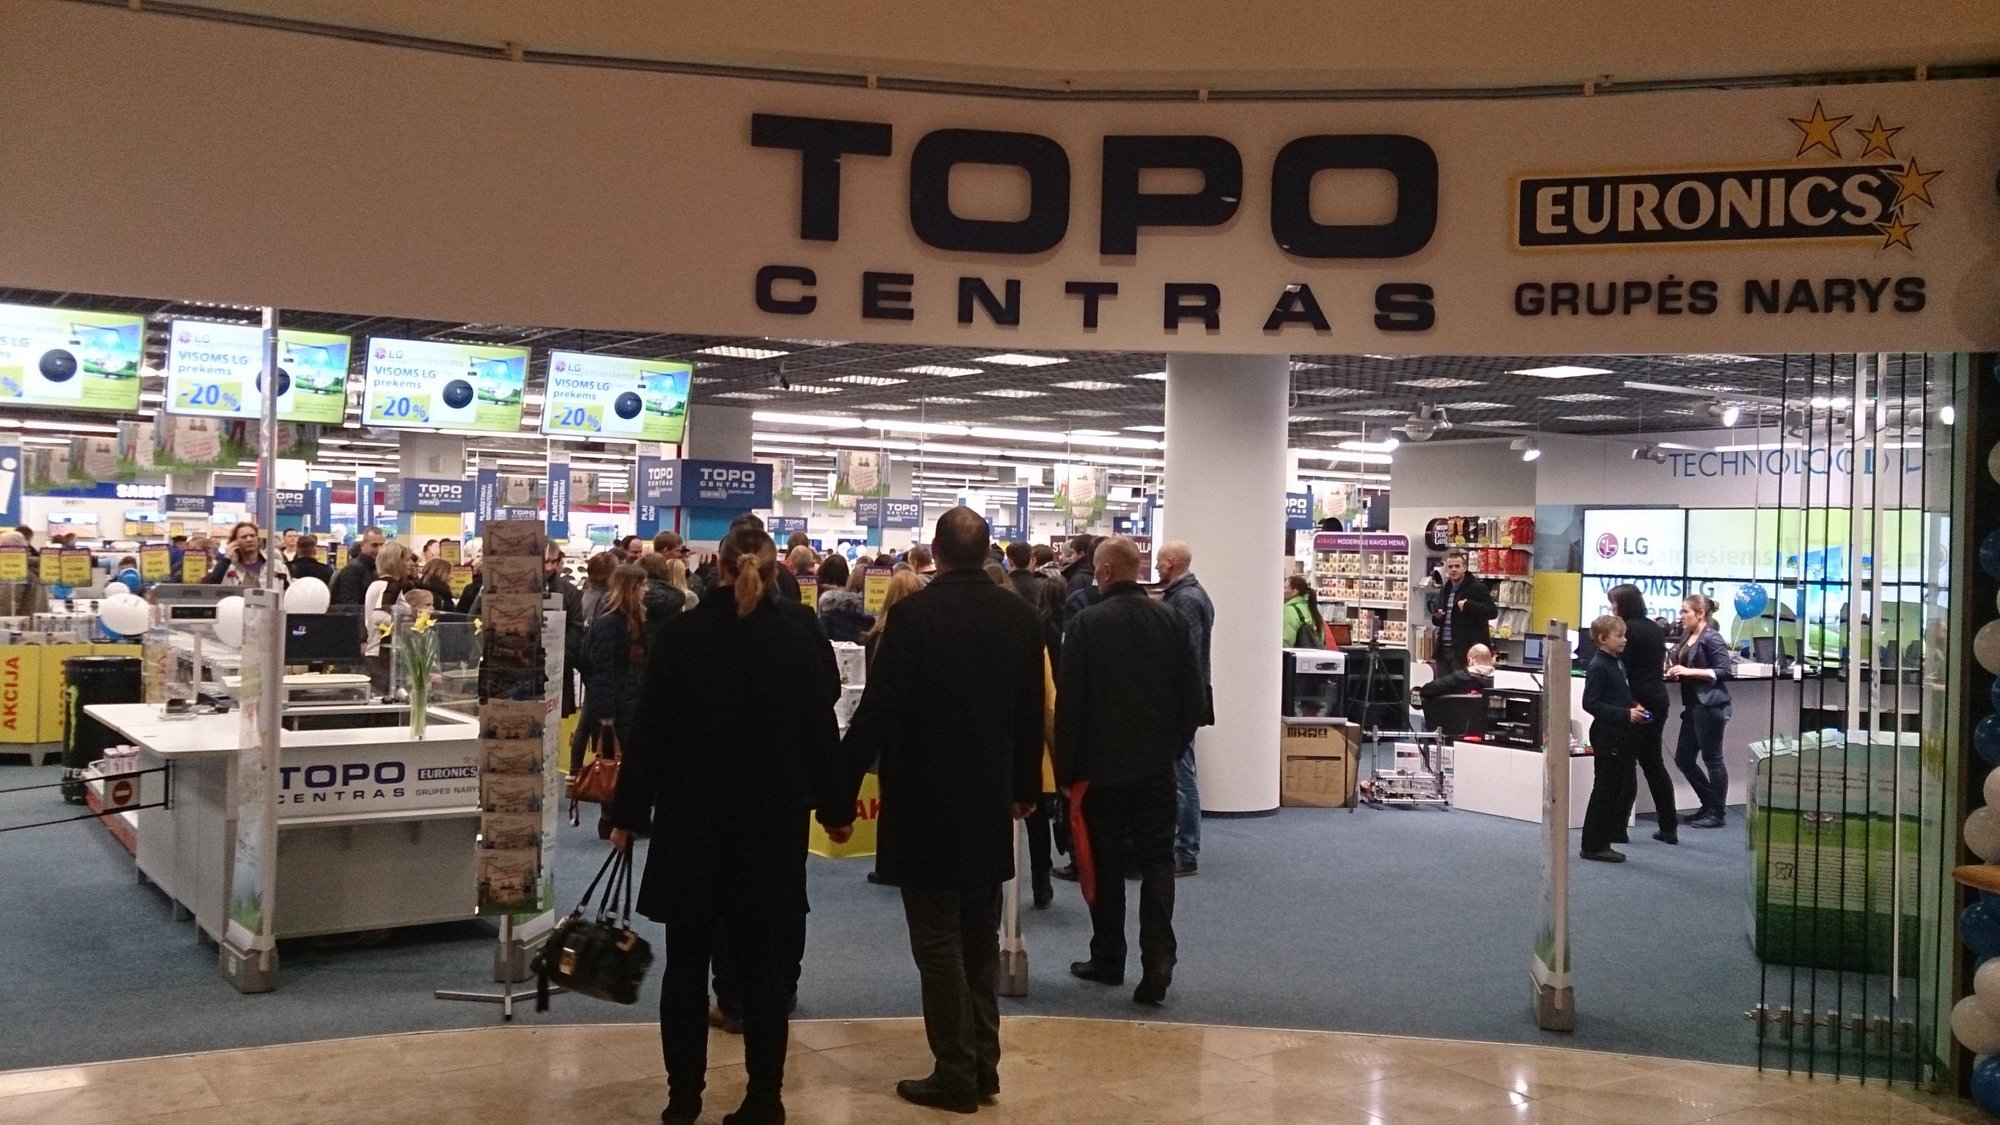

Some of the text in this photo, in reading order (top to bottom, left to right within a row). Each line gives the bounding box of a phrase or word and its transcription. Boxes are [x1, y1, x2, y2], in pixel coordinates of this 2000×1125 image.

[751, 113, 1439, 258] TOPO
[1536, 173, 1882, 235] EURONICS
[755, 264, 1437, 332] CENTRAS
[1514, 274, 1927, 317] GRUPĖS NARYS
[178, 351, 248, 365] VISOMS LG
[374, 366, 437, 379] VISOMS LG
[568, 364, 581, 373] LG
[555, 378, 610, 391] VISOMS LG
[648, 467, 674, 480] TOPO
[700, 468, 756, 482] TOPO
[418, 484, 462, 494] TOPO
[700, 481, 756, 489] CENTRAS
[276, 492, 304, 500] OPO
[859, 503, 878, 511] TOPO
[887, 503, 918, 512] TOPO
[1623, 537, 1649, 556] LG
[866, 568, 892, 576] AKCIJA
[3, 656, 20, 731] AKCIJA
[279, 761, 406, 790] TOPO
[420, 767, 477, 779] EURONICS
